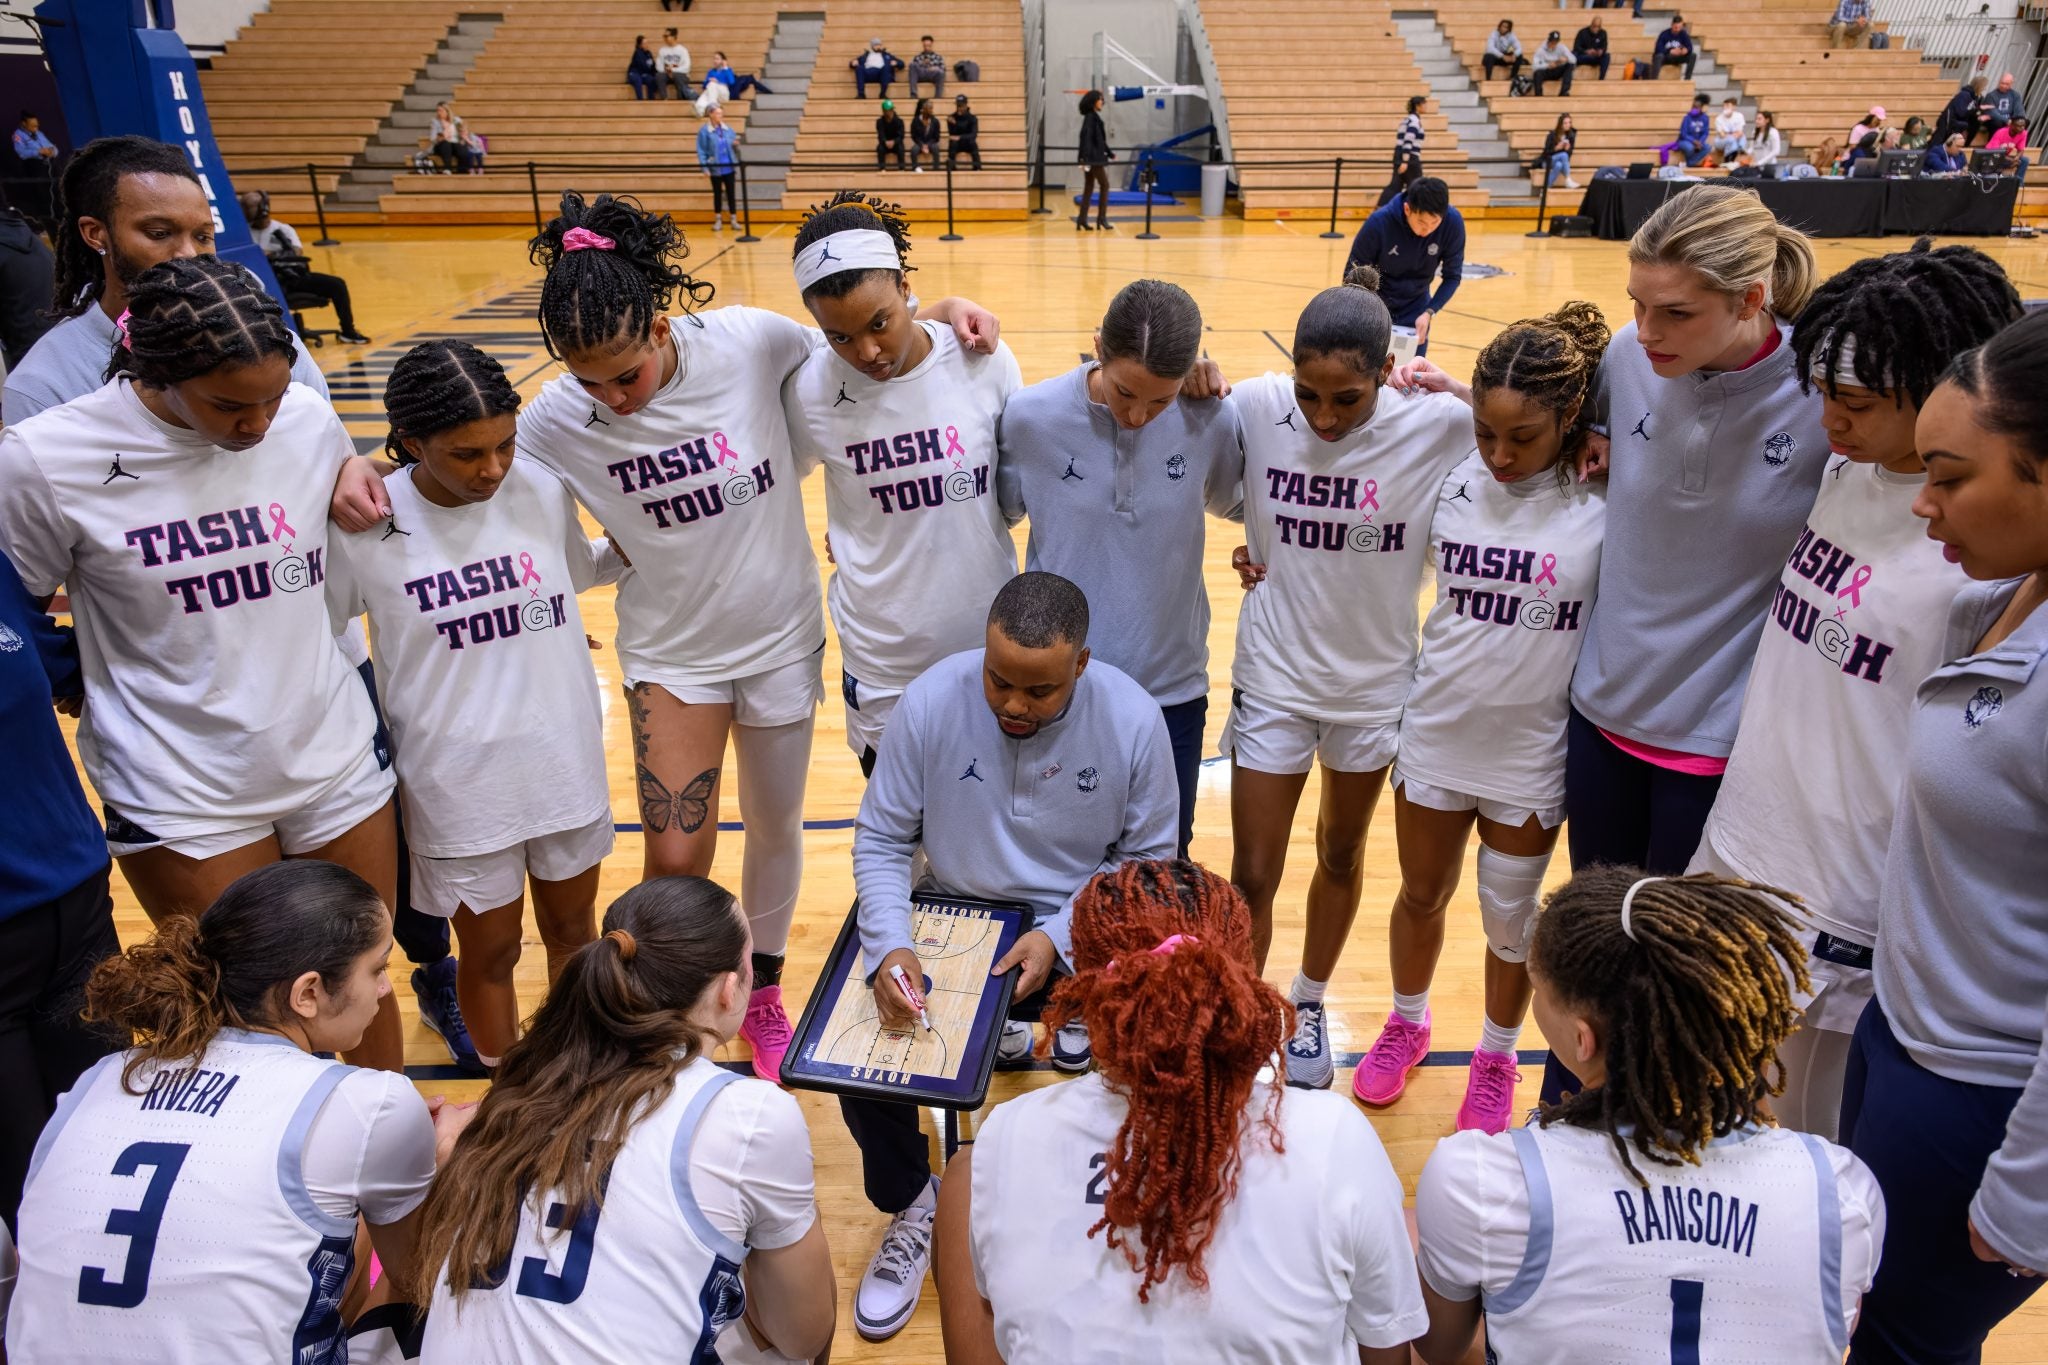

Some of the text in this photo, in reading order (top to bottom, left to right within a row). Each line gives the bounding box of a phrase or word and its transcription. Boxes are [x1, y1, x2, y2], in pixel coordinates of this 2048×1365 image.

[607, 437, 717, 494] TASH
[845, 428, 944, 475] TASH
[642, 458, 775, 529] TOUGH
[869, 464, 989, 514] TOUGH
[1266, 467, 1359, 509] TASH
[124, 506, 270, 568] TASH
[1275, 514, 1406, 552] TOUGH
[1788, 523, 1856, 596] ASH
[165, 547, 324, 614] TOUGH
[404, 555, 520, 613] TASH
[1441, 540, 1536, 584] TASH
[436, 593, 567, 650] TOUGH
[1449, 586, 1583, 631] TOUGH
[913, 903, 992, 919] ORGETOWN
[140, 1067, 240, 1118] RIVERA
[851, 1067, 911, 1084] HOYAS
[78, 1141, 192, 1308] 3
[1614, 1185, 1759, 1257] RANSOM
[1670, 1279, 1704, 1365] 1
